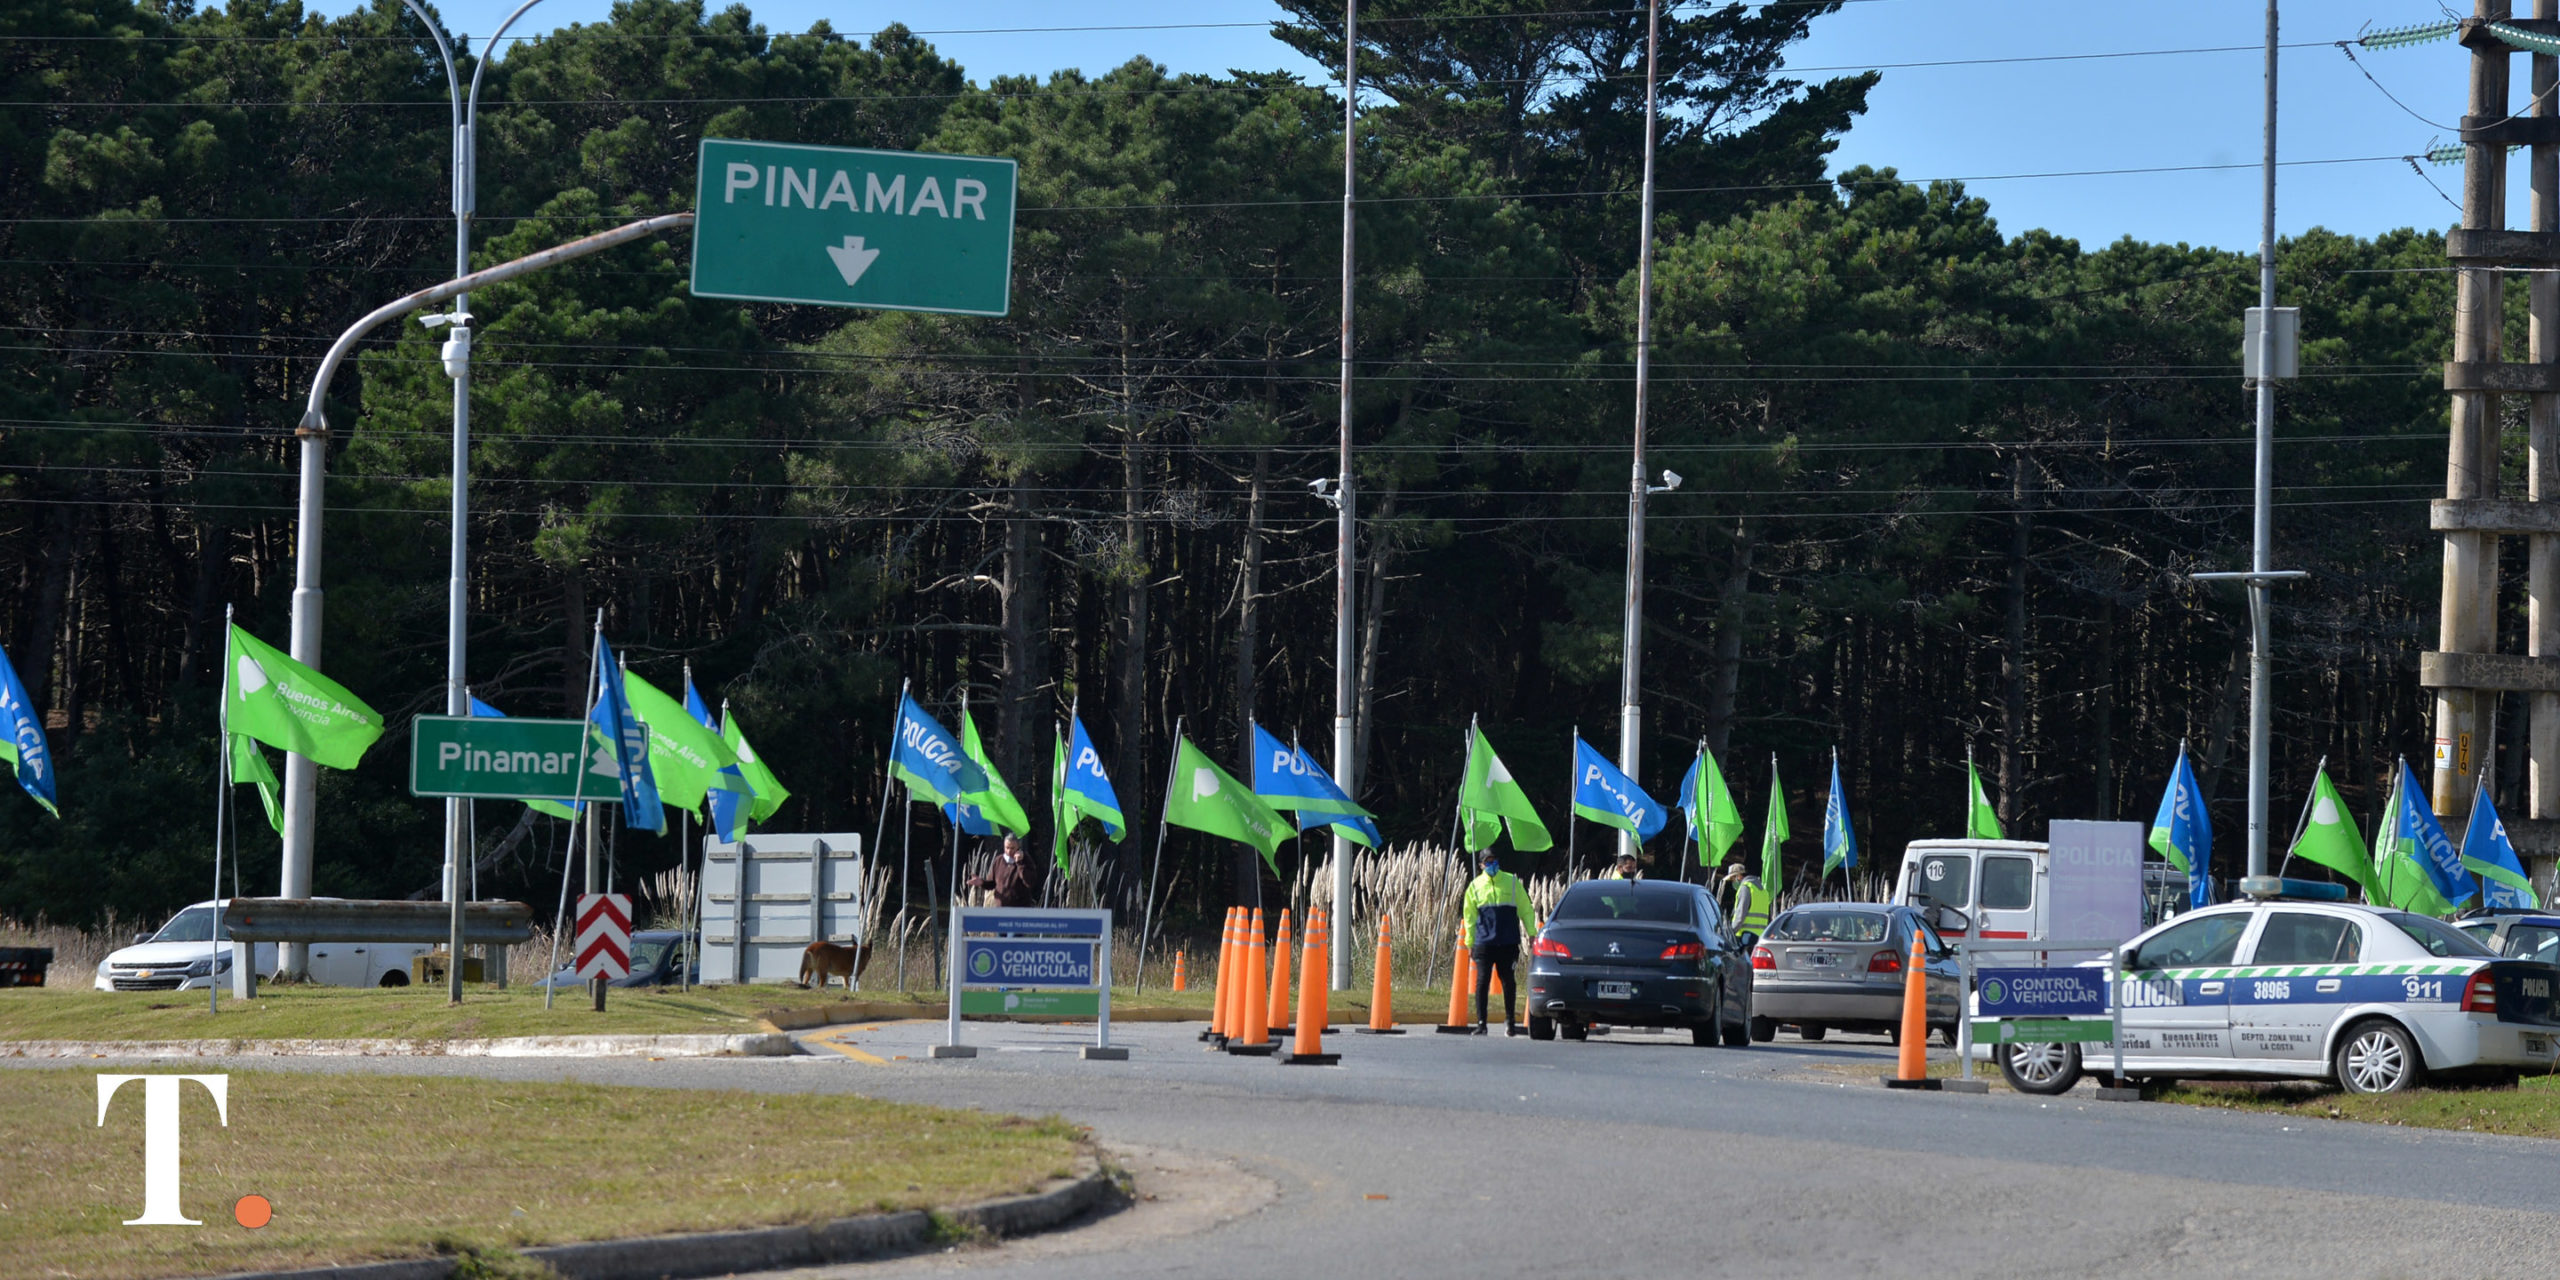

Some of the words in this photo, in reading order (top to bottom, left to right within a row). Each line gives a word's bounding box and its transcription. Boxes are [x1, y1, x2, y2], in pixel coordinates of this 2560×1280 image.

[724, 162, 987, 221] PINAMAR
[277, 681, 329, 711] Buenos
[331, 702, 368, 725] Aires
[902, 716, 962, 775] POLICIA
[439, 741, 575, 775] Pinamar
[2460, 735, 2468, 776] 079
[2055, 845, 2136, 867] POLICIA
[1928, 864, 1945, 877] 110
[1002, 950, 1075, 964] CONTROL
[1002, 964, 1088, 977] VEHICULAR
[2012, 978, 2084, 990] CONTROL
[2254, 981, 2290, 1000] 38965
[2406, 981, 2442, 998] 911
[2522, 978, 2550, 998] POLICIA
[2012, 990, 2098, 1003] VEHICULAR
[2103, 1040, 2150, 1049] Seridad
[2162, 1032, 2194, 1042] Buenos
[2196, 1032, 2218, 1042] Aires
[2268, 1034, 2287, 1042] ZONA
[2271, 1043, 2294, 1051] COSTA
